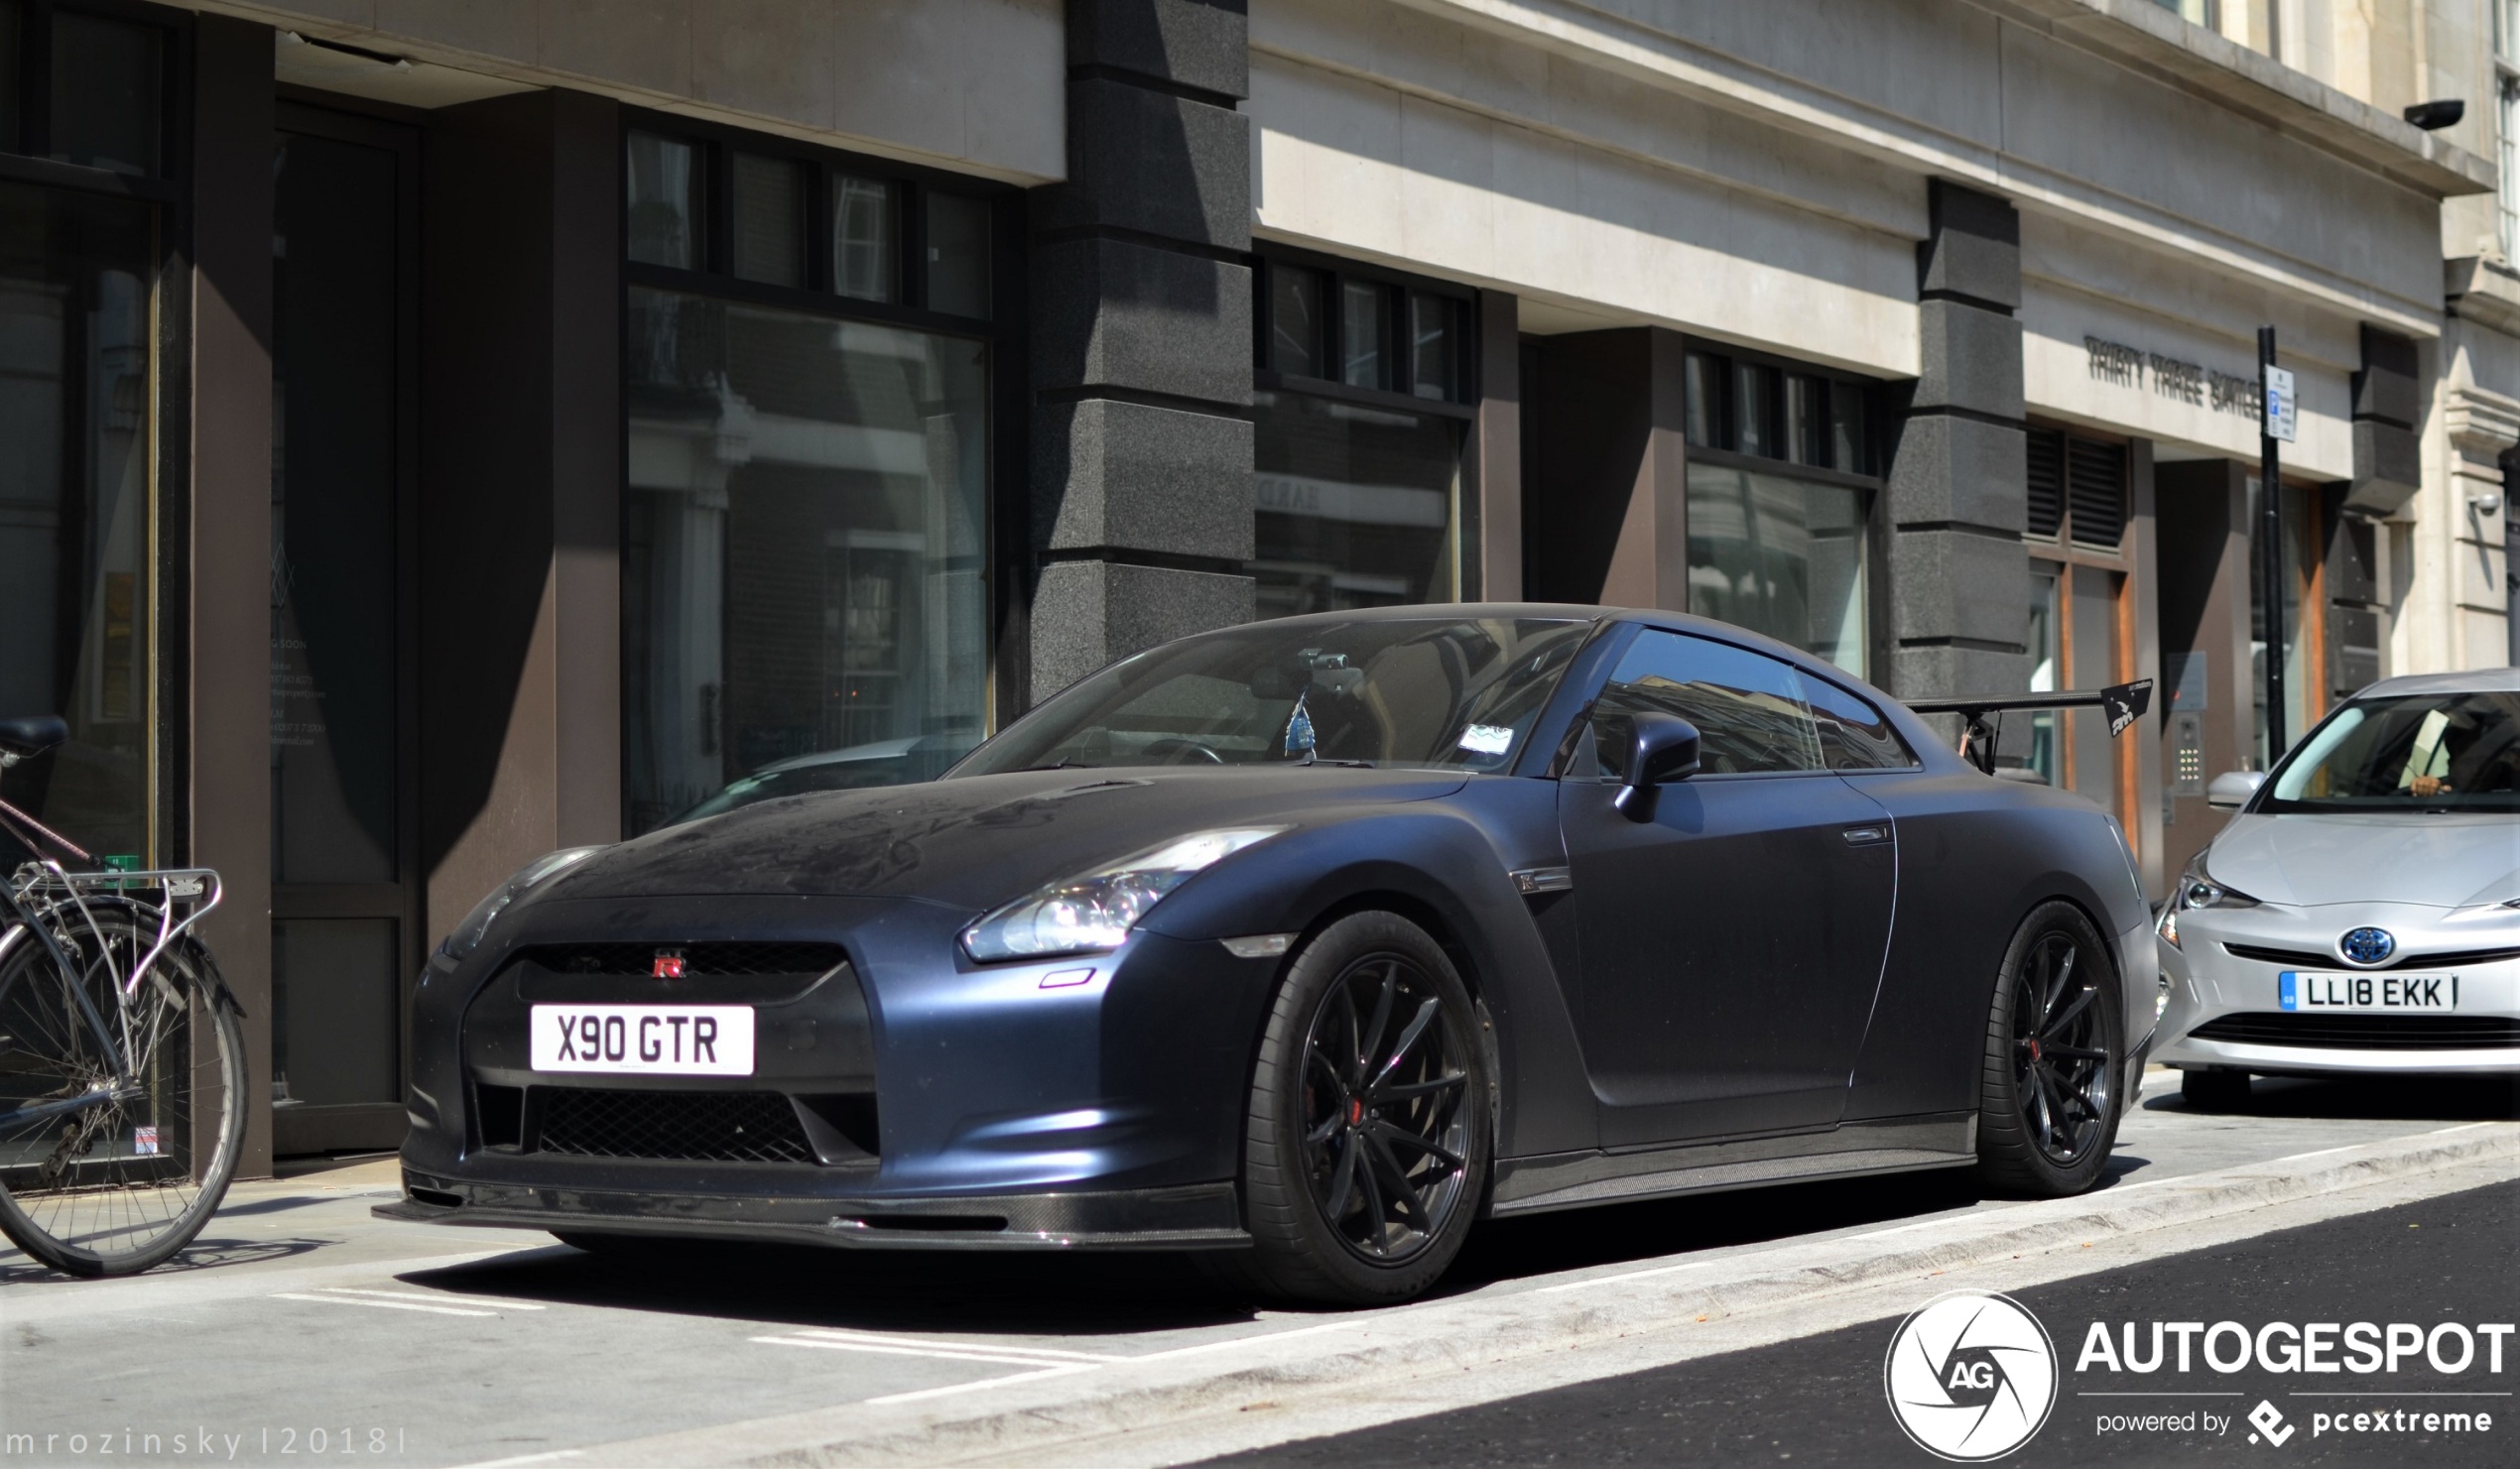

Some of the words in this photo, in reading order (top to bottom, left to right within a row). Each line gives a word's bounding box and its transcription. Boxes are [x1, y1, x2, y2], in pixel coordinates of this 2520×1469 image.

[2084, 335, 2145, 390] THIRTY
[2150, 353, 2204, 407] THREE
[2308, 978, 2373, 1006] LL18
[2383, 978, 2442, 1007] EKK
[558, 1015, 626, 1062] X90
[639, 1015, 718, 1064] GTR
